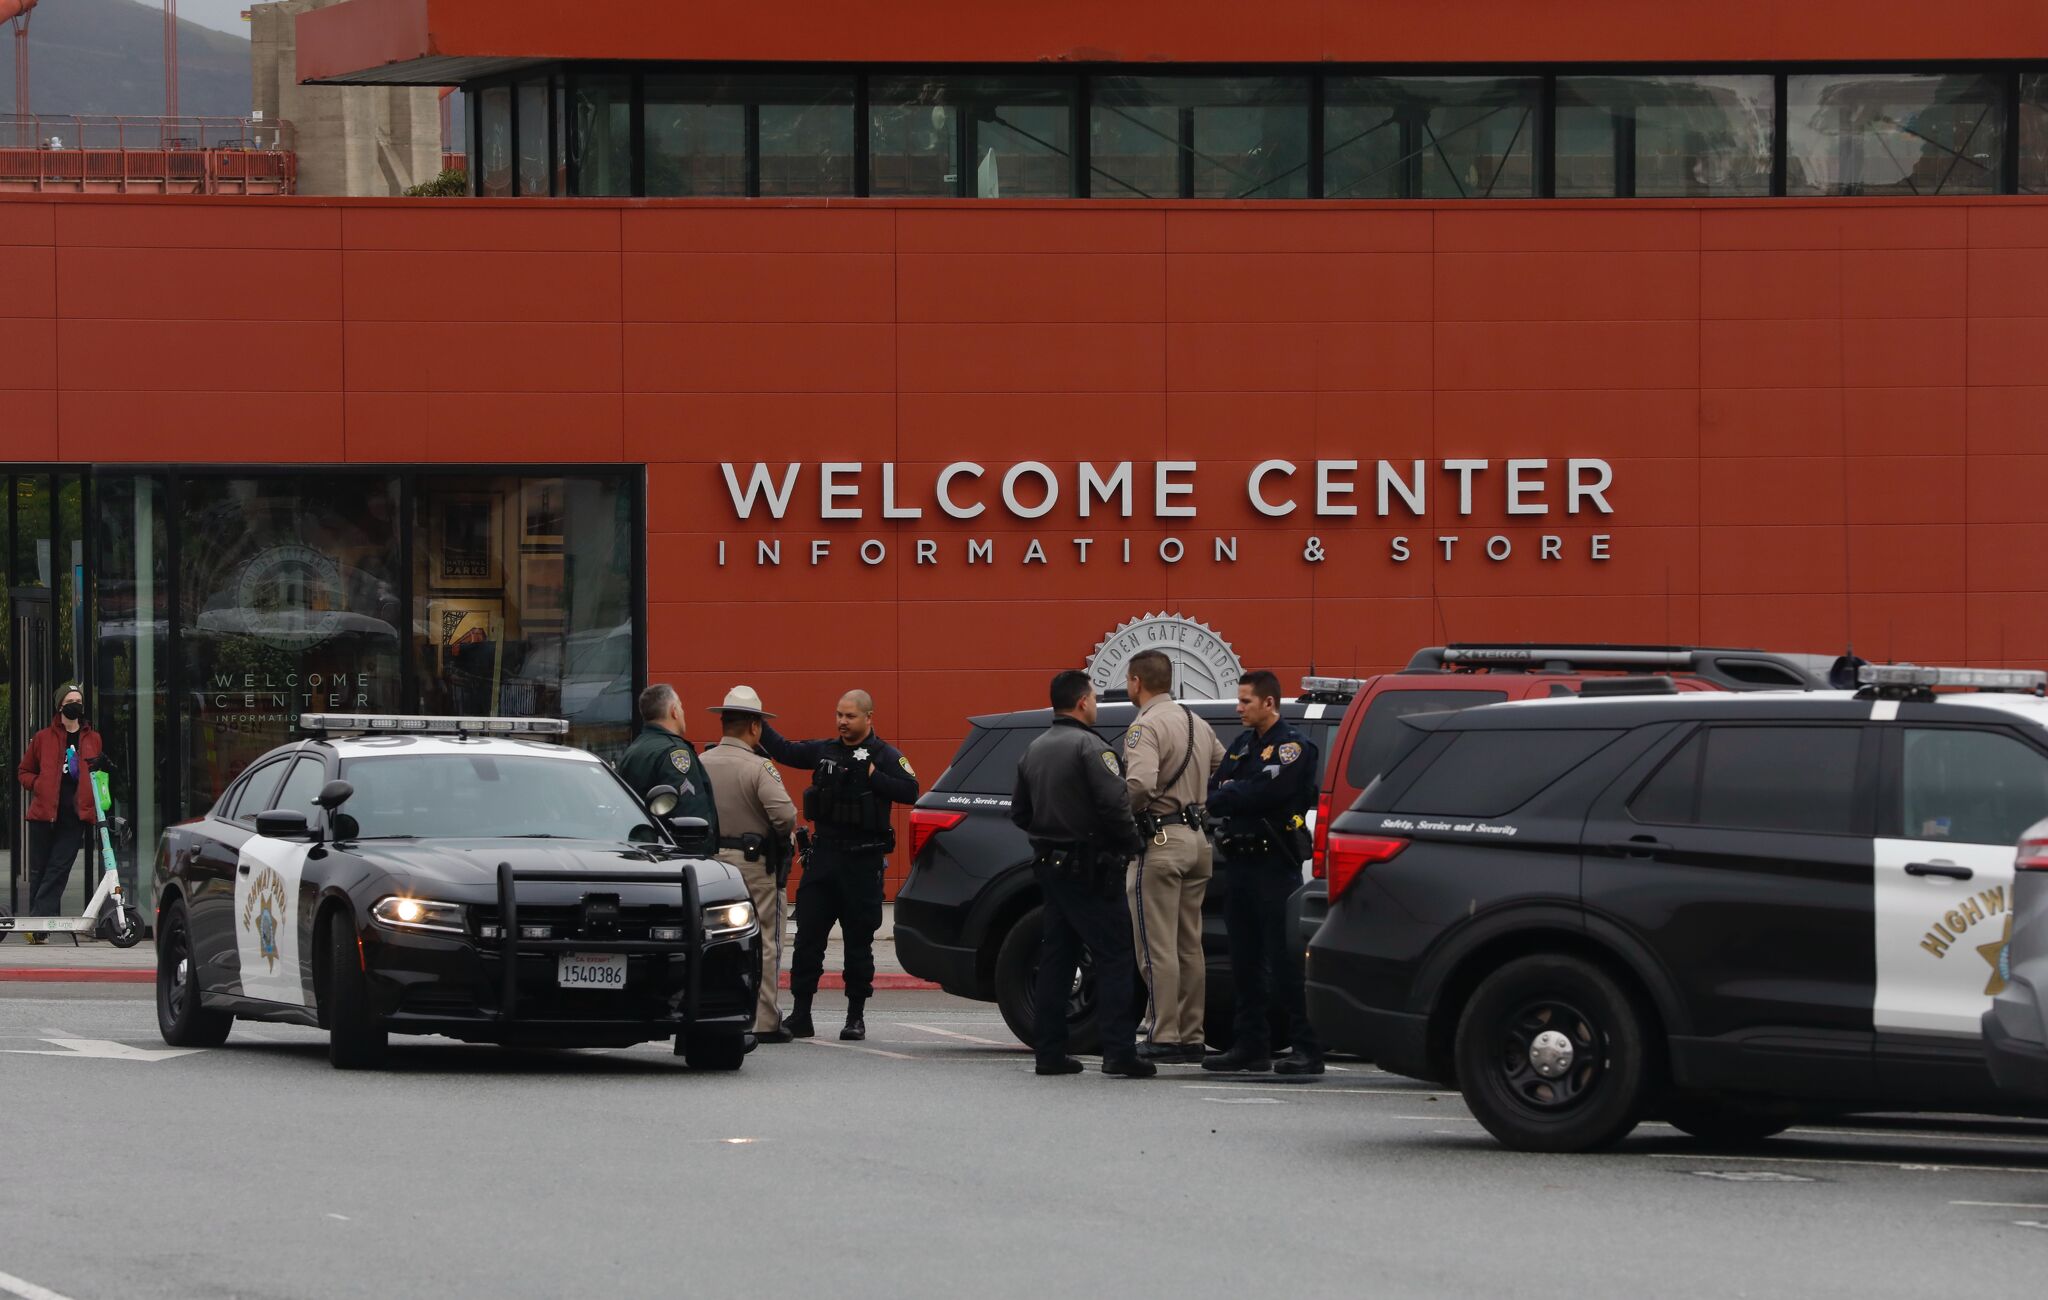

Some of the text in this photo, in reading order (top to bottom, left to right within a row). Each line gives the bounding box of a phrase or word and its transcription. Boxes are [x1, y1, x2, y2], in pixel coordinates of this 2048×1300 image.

[720, 458, 1614, 519] WELCOME CENTER
[718, 534, 1611, 566] INFORMATION & STORE
[446, 566, 486, 575] PARKS
[1093, 625, 1239, 688] GOLDEN GATE BRIDGE
[1455, 649, 1531, 660] XTERRA
[215, 673, 369, 688] WELCOME
[215, 693, 369, 708] CENTER
[216, 714, 298, 722] INFORMATIO
[948, 796, 971, 805] Safety,
[973, 797, 998, 806] Service
[1381, 818, 1517, 836] Safety, Service and Security
[1919, 883, 2014, 959] HIGHW
[563, 965, 622, 984] 1540386
